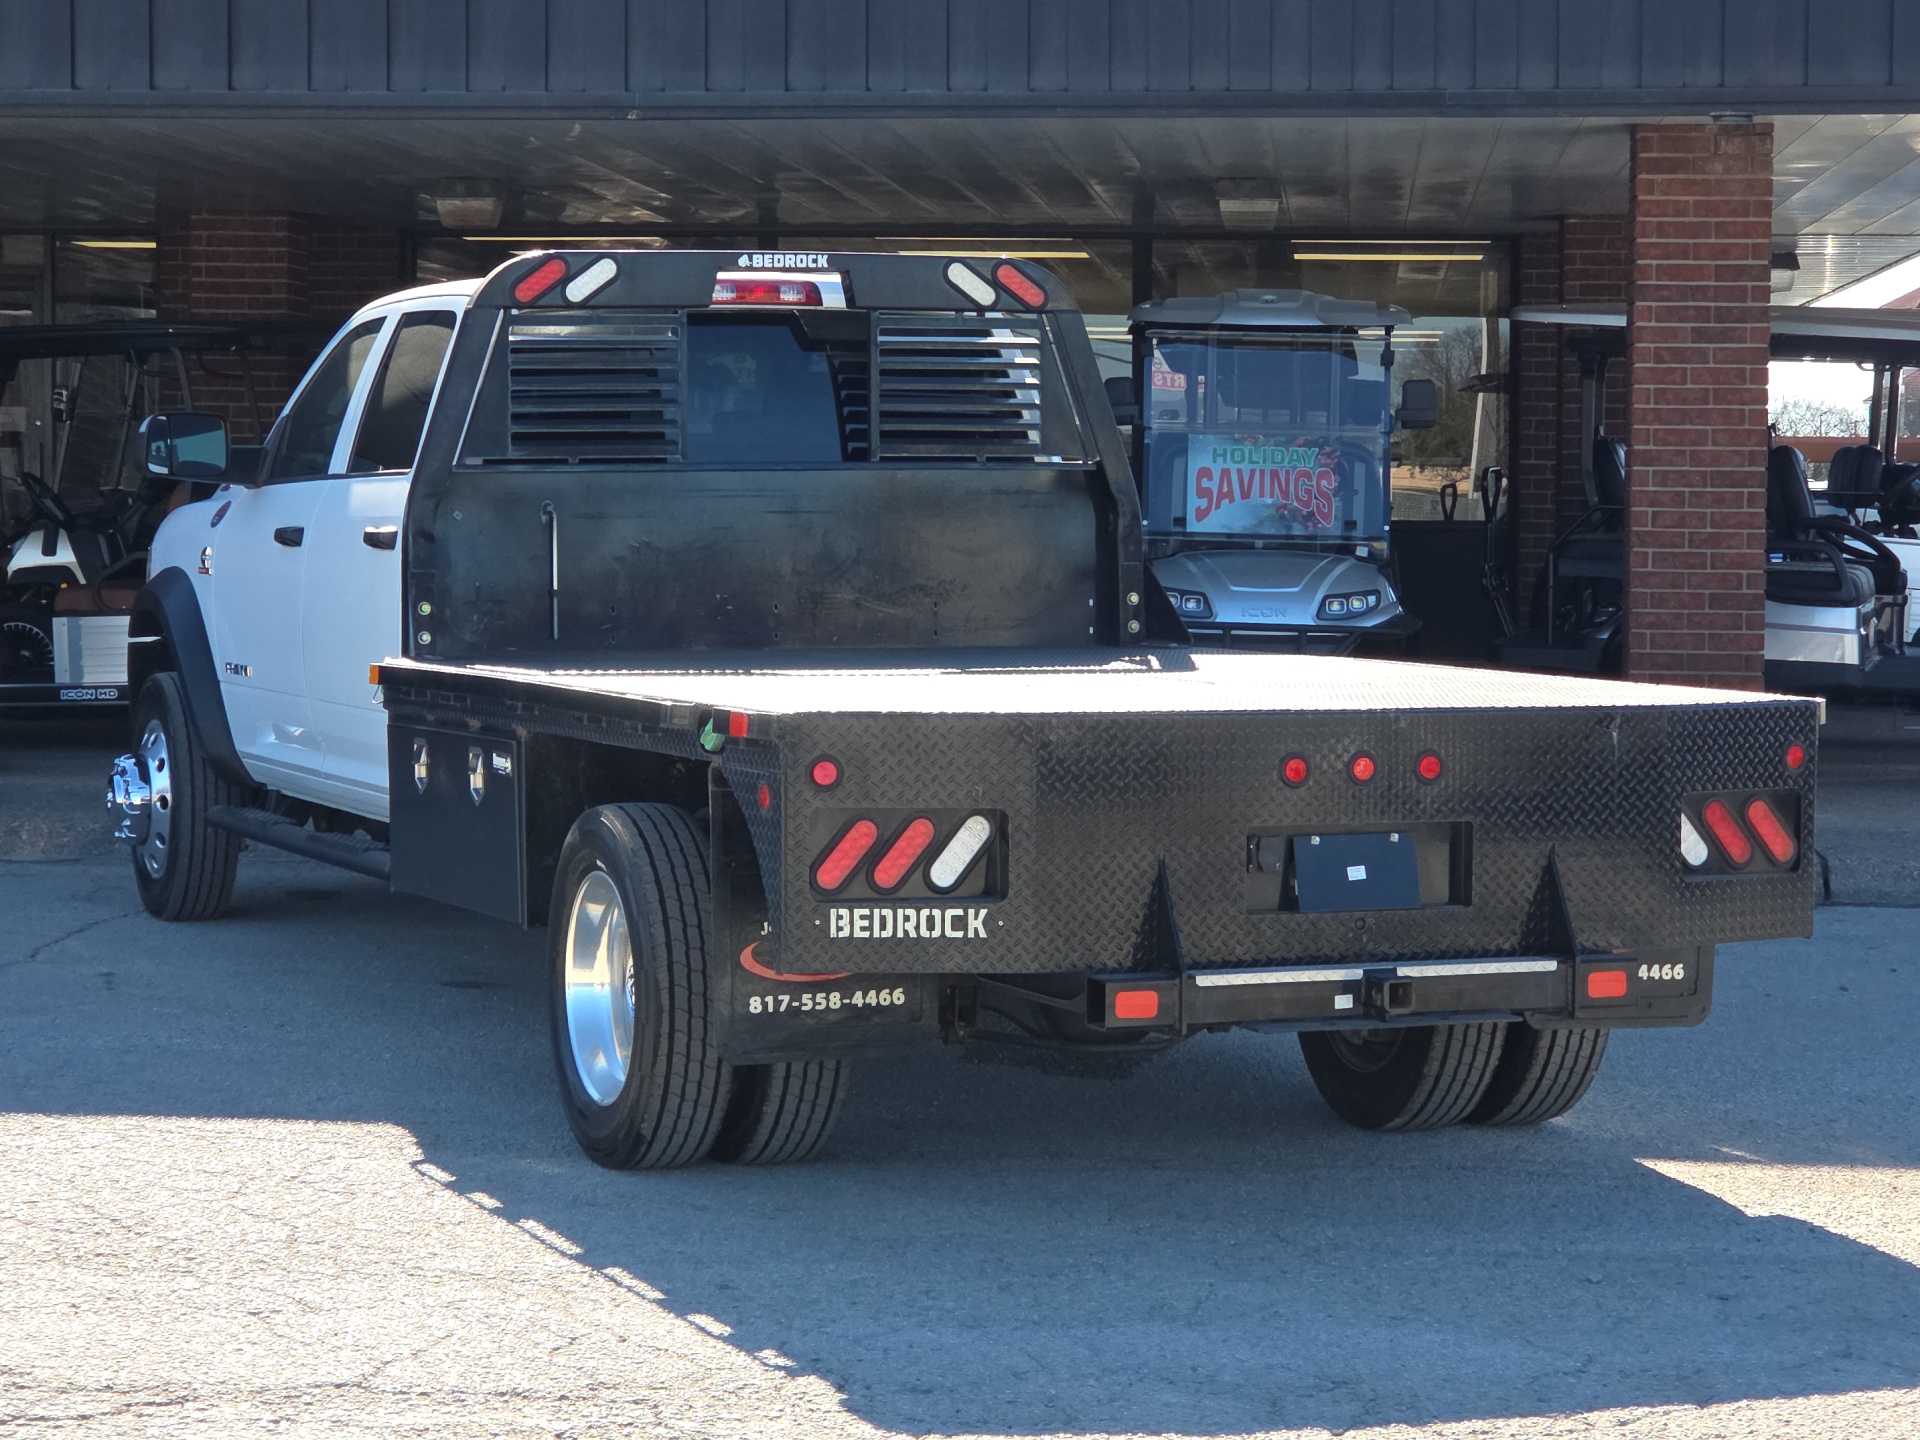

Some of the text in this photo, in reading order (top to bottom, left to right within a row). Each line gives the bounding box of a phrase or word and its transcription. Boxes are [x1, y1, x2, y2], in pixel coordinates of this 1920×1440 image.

[752, 254, 829, 268] BEDROCK
[1211, 446, 1319, 467] HOLIDAY
[1194, 466, 1335, 528] SAVINGS
[1241, 607, 1289, 618] ICON
[60, 688, 118, 700] ICON HD
[829, 907, 989, 939] BEDROCK
[748, 987, 906, 1014] 817-558-4466
